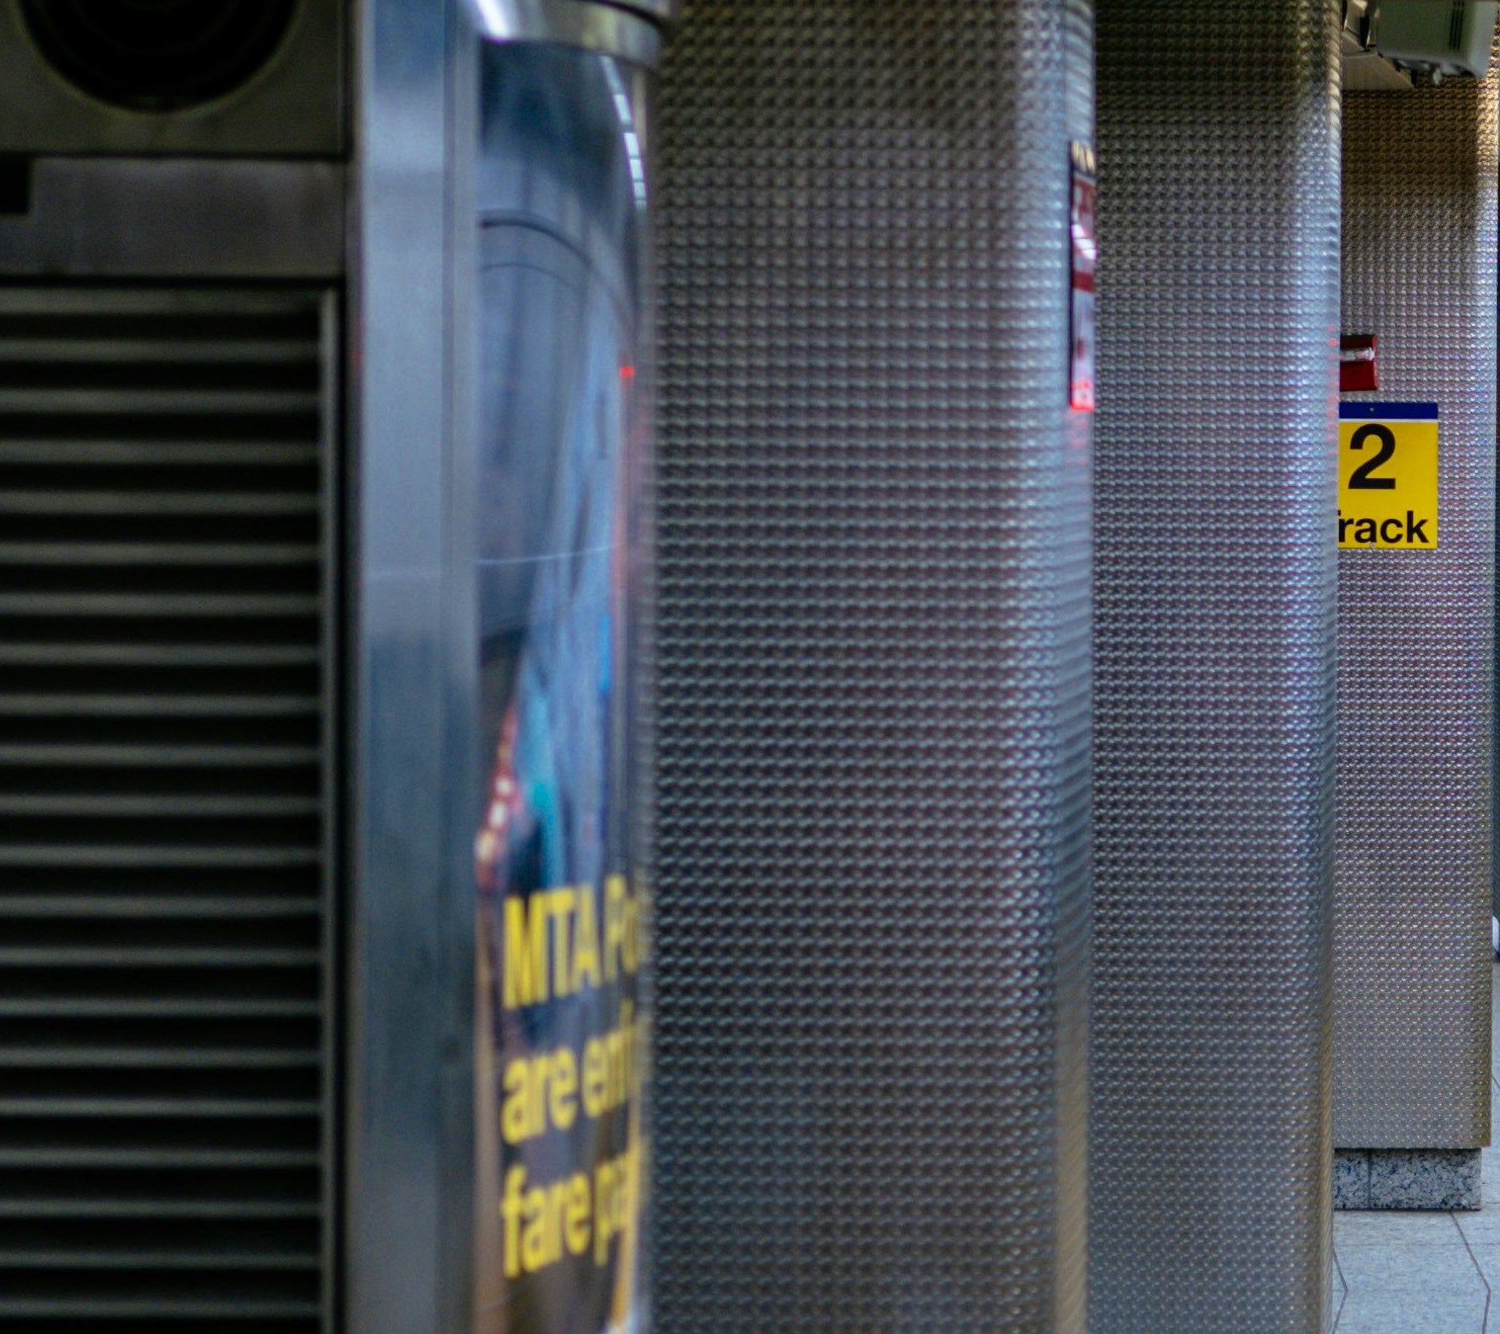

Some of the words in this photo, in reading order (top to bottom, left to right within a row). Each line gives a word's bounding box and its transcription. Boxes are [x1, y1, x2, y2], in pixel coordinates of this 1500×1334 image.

[1348, 423, 1396, 490] 2
[1337, 510, 1430, 544] rack
[503, 883, 602, 1009] MTA
[502, 1044, 578, 1146] are
[501, 1164, 591, 1278] fare
